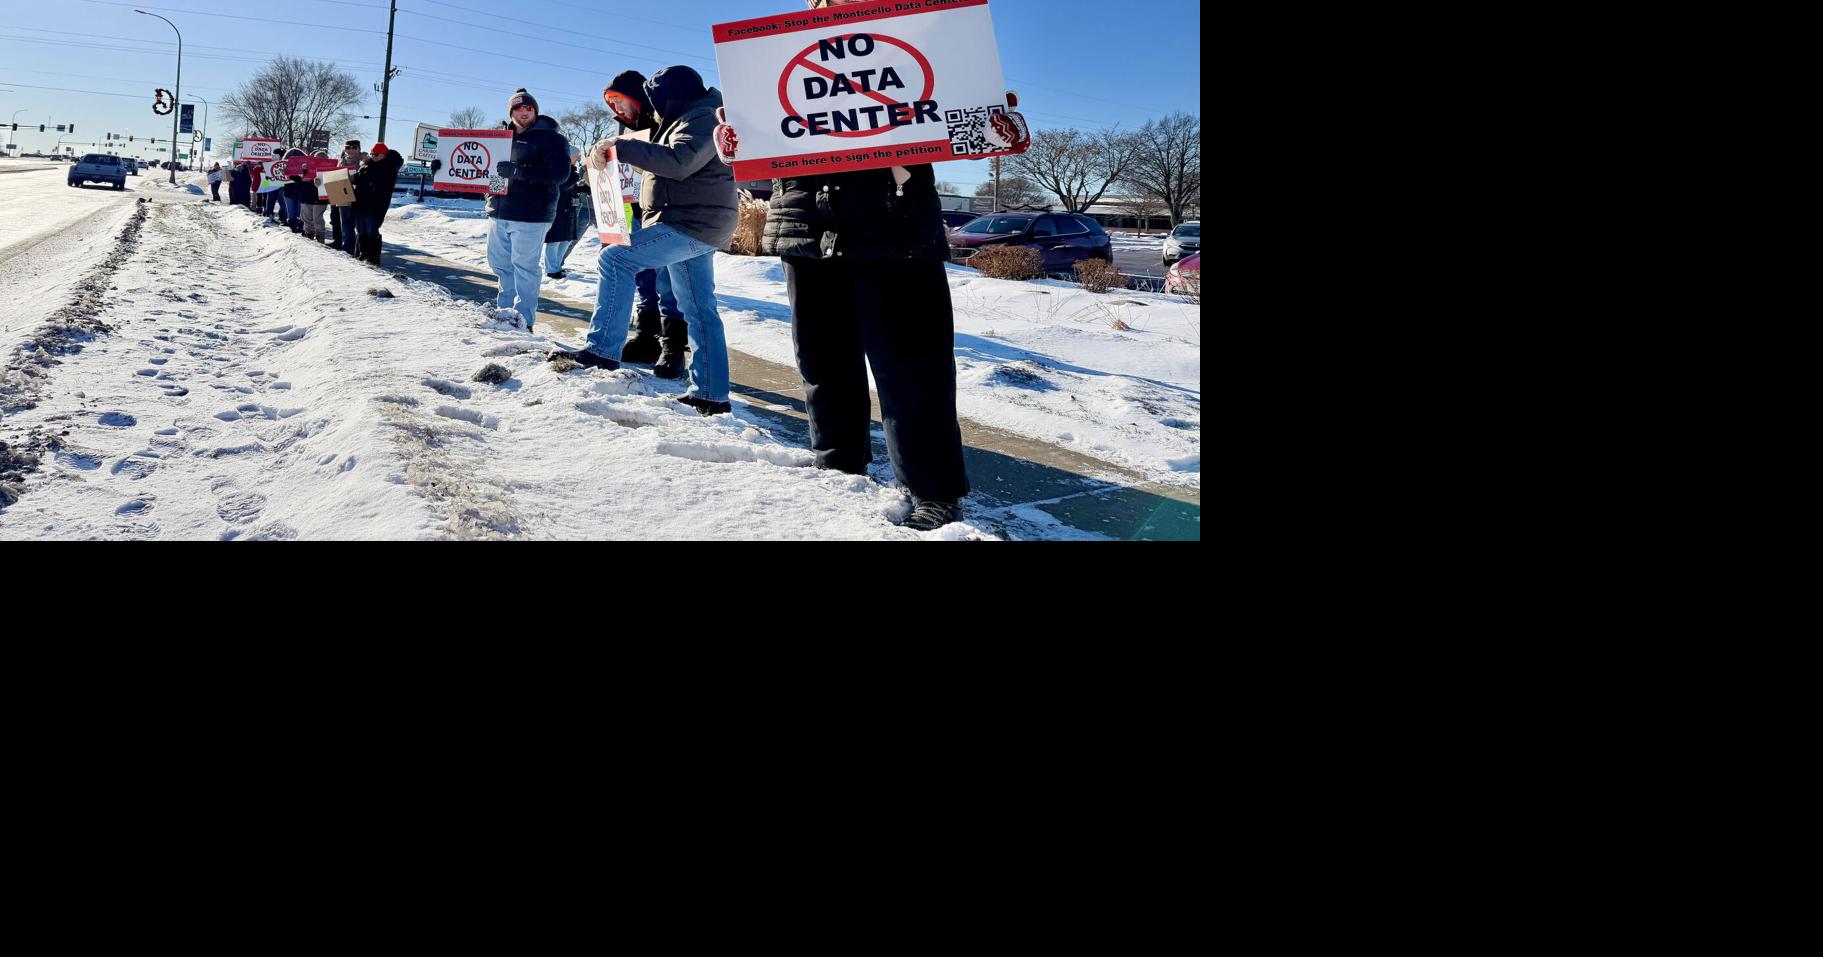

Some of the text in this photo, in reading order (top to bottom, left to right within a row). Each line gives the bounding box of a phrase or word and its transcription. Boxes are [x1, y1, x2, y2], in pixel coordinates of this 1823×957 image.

[728, 23, 782, 36] Facebook:
[784, 19, 809, 28] Stop
[812, 15, 830, 24] the
[833, 6, 892, 20] Monticello
[895, 2, 921, 11] Data
[818, 33, 875, 61] NO
[803, 66, 905, 100] DATA
[781, 100, 942, 138] CENTER
[463, 142, 479, 151] NO
[771, 145, 942, 169] Scan here to sign the petition
[457, 155, 483, 165] DATA
[448, 168, 490, 179] CENTER
